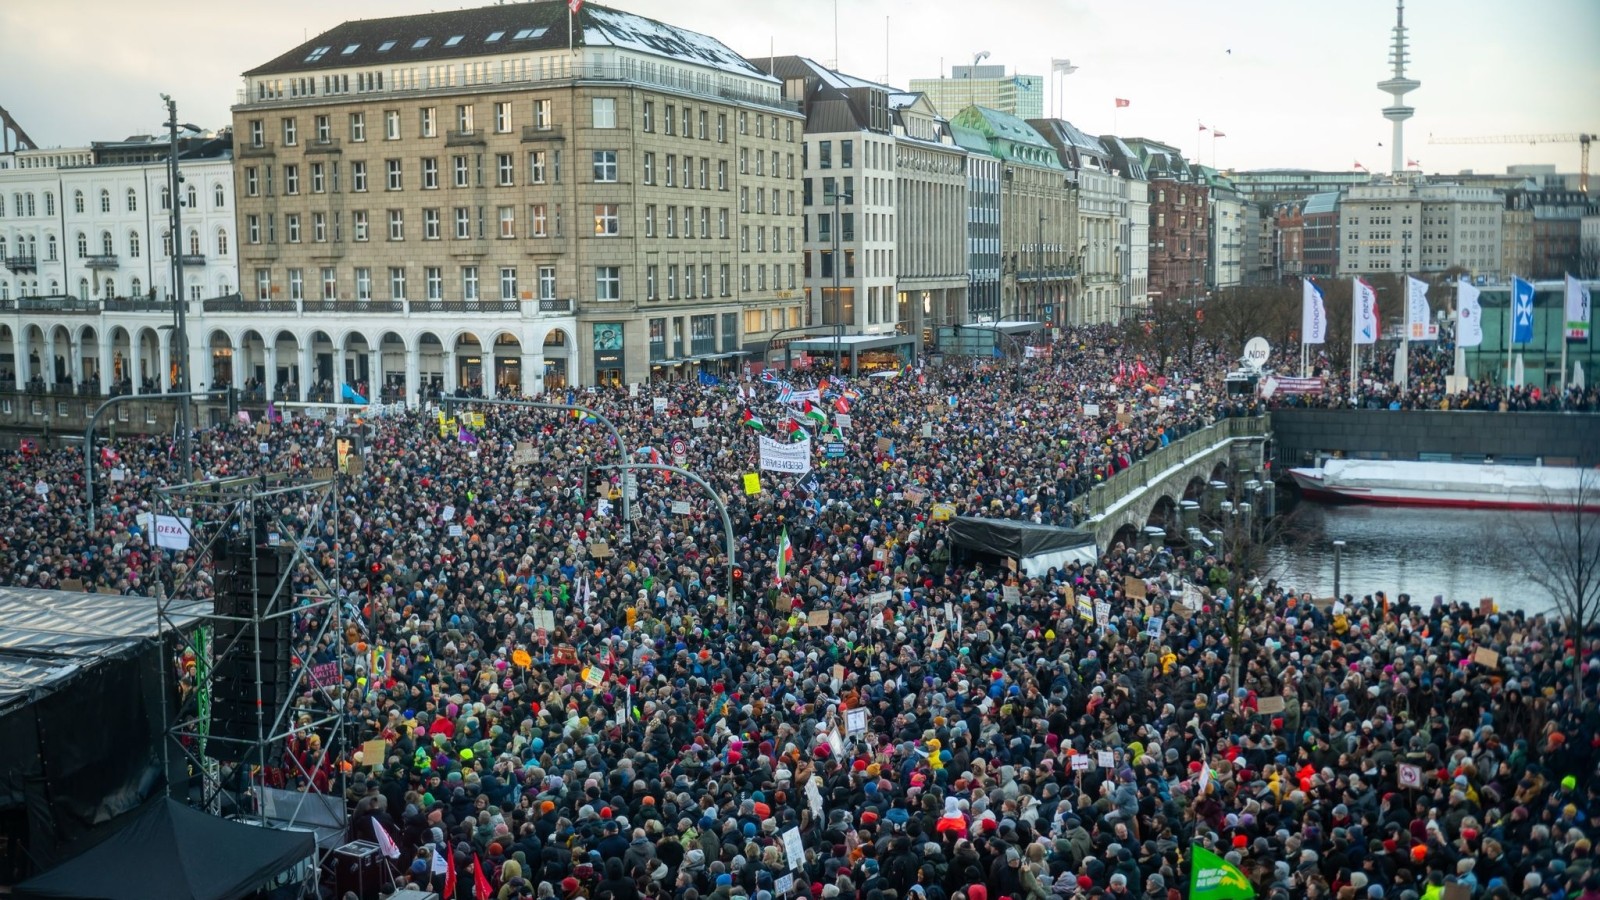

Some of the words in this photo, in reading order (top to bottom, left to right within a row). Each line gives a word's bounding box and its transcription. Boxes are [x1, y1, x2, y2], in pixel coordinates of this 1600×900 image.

[1021, 243, 1062, 253] ALSTRHAUS
[1045, 306, 1052, 314] U
[1312, 288, 1320, 339] OLDENDORF
[1248, 350, 1266, 359] NDR
[676, 443, 683, 452] 30
[157, 525, 182, 535] DEXA
